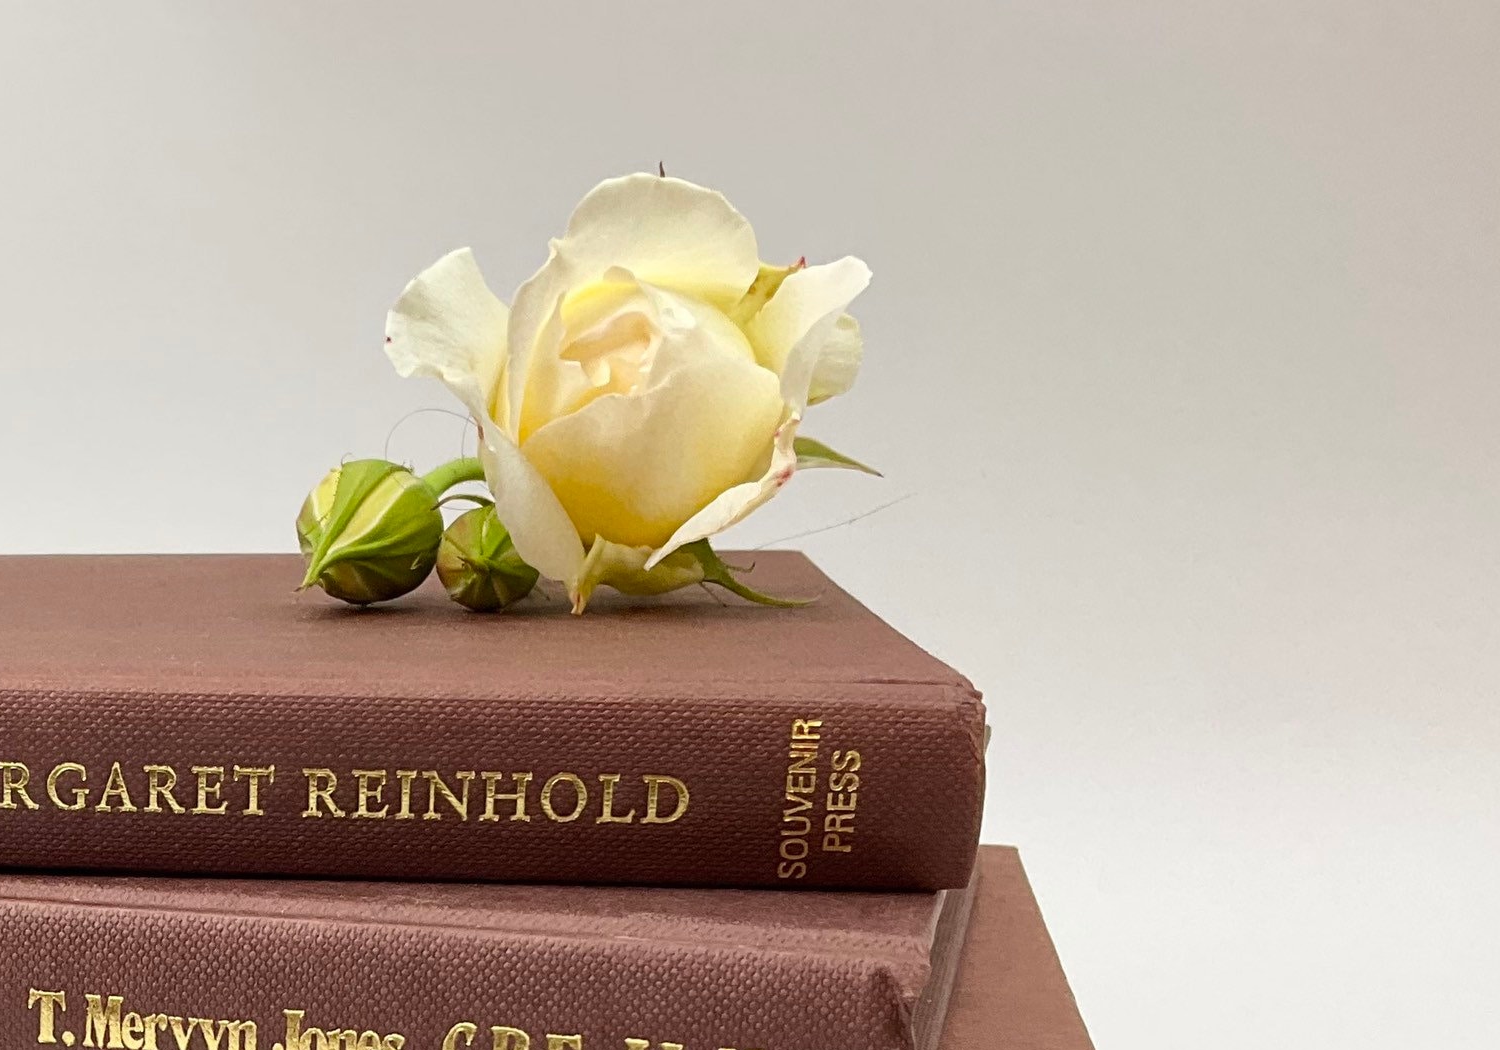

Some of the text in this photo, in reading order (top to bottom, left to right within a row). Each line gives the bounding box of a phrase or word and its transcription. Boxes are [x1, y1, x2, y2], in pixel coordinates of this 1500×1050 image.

[302, 767, 691, 825] REINHOLD
[777, 718, 824, 879] SOUVENIR
[823, 750, 861, 852] PRESS
[28, 988, 73, 1047] T.
